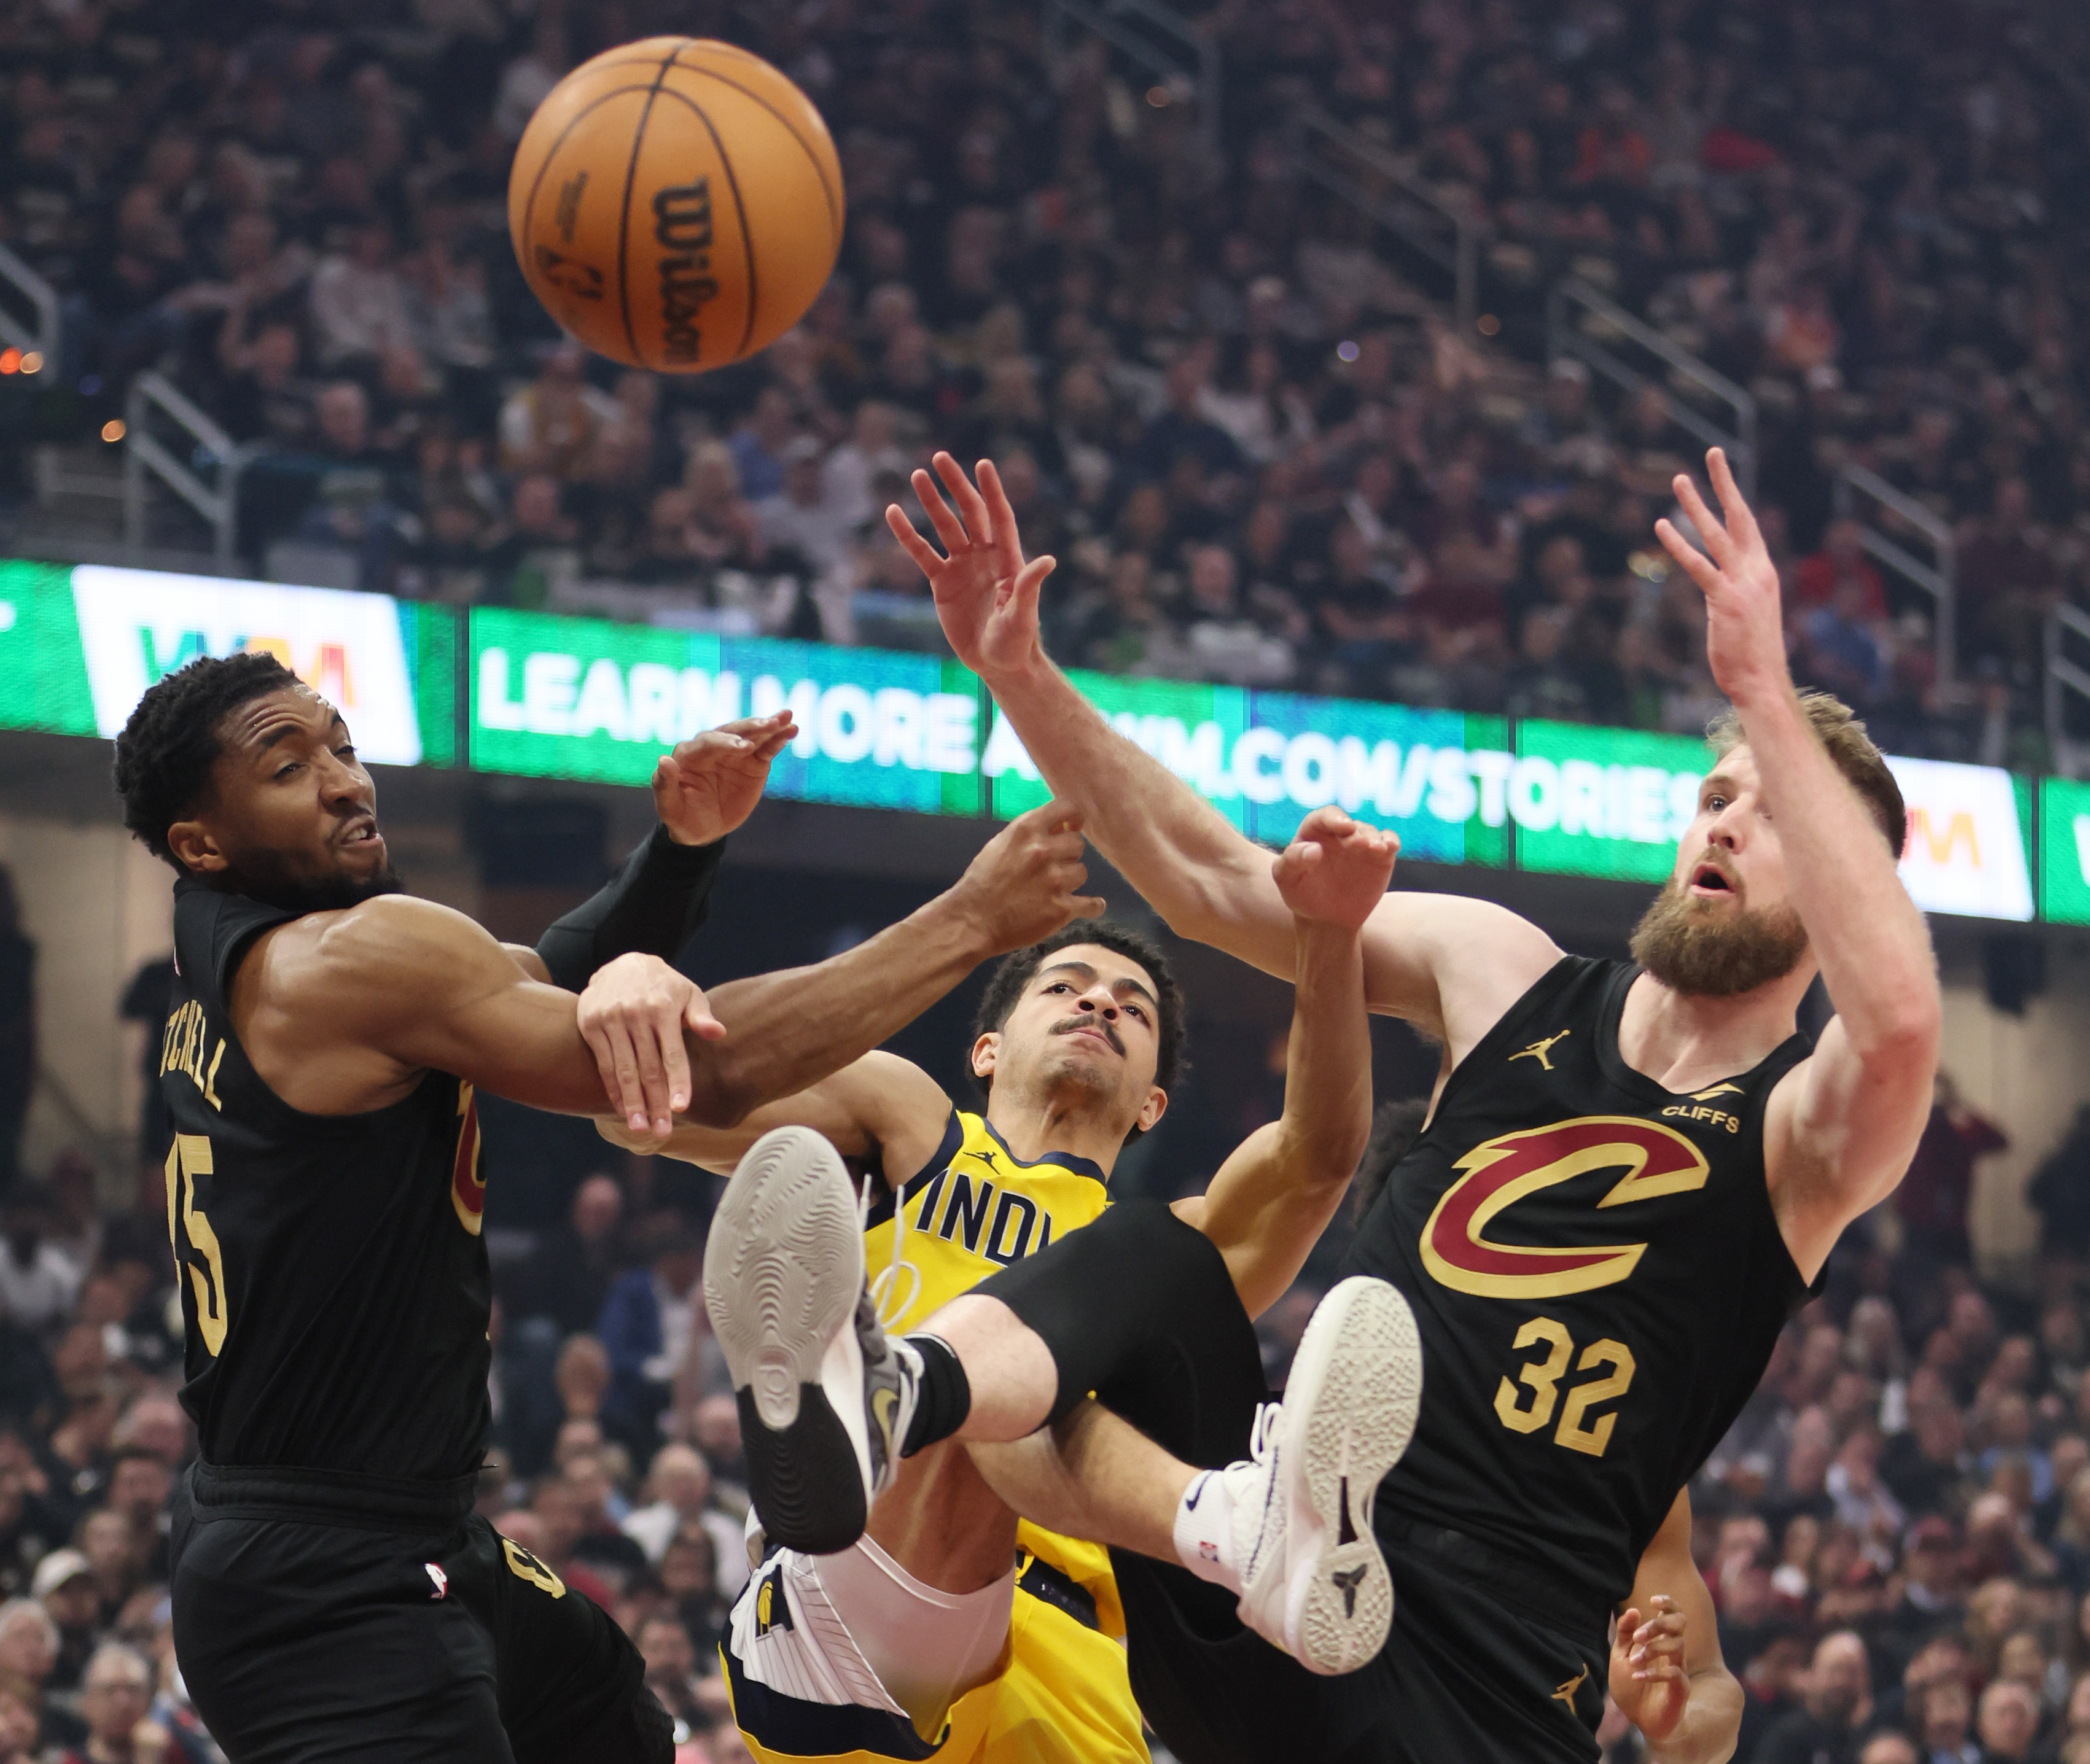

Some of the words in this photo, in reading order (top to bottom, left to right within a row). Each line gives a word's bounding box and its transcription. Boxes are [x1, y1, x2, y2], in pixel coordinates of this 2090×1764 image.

[652, 175, 719, 363] Wilson
[477, 646, 742, 747] LEARN
[749, 673, 978, 774] MORE
[1661, 1105, 1741, 1134] CLIFFS
[913, 1167, 1059, 1269] INDI
[1419, 1114, 1711, 1300] C
[1493, 1316, 1637, 1458] 32
